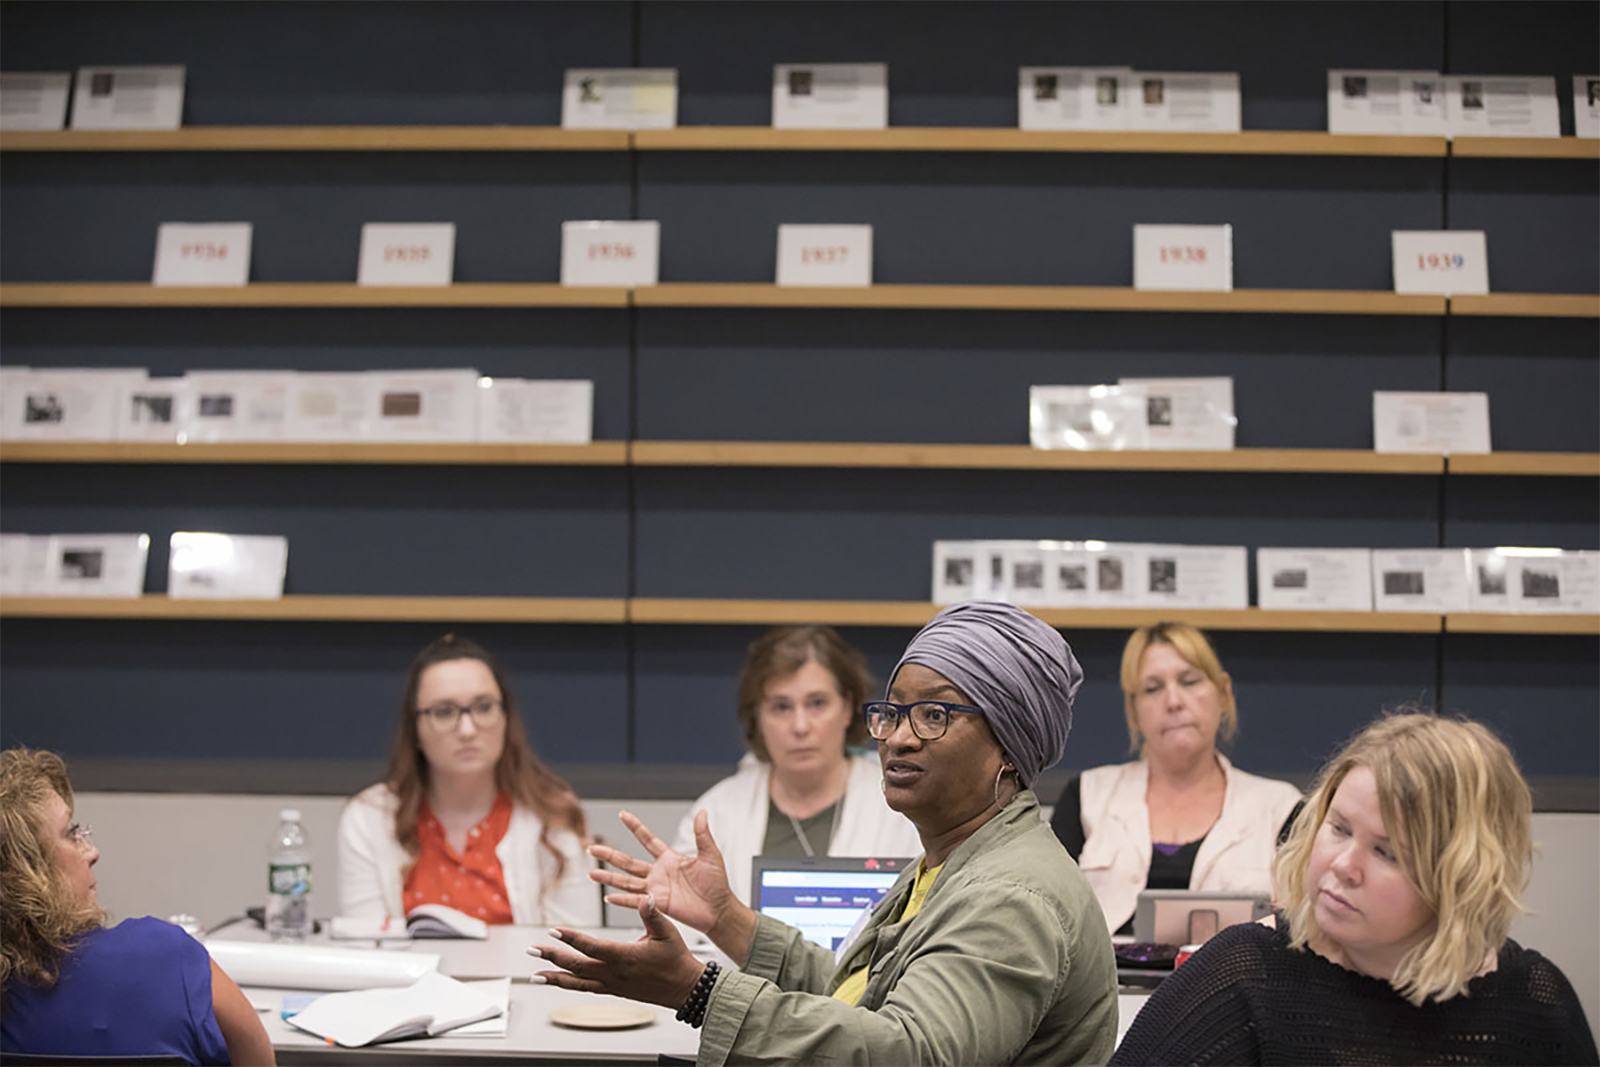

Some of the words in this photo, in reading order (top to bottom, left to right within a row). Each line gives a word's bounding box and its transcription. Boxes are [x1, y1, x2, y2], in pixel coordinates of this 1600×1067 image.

[588, 243, 635, 260] 1936
[801, 246, 849, 263] 1937
[1159, 246, 1207, 263] 1938
[1418, 254, 1464, 271] 1939
